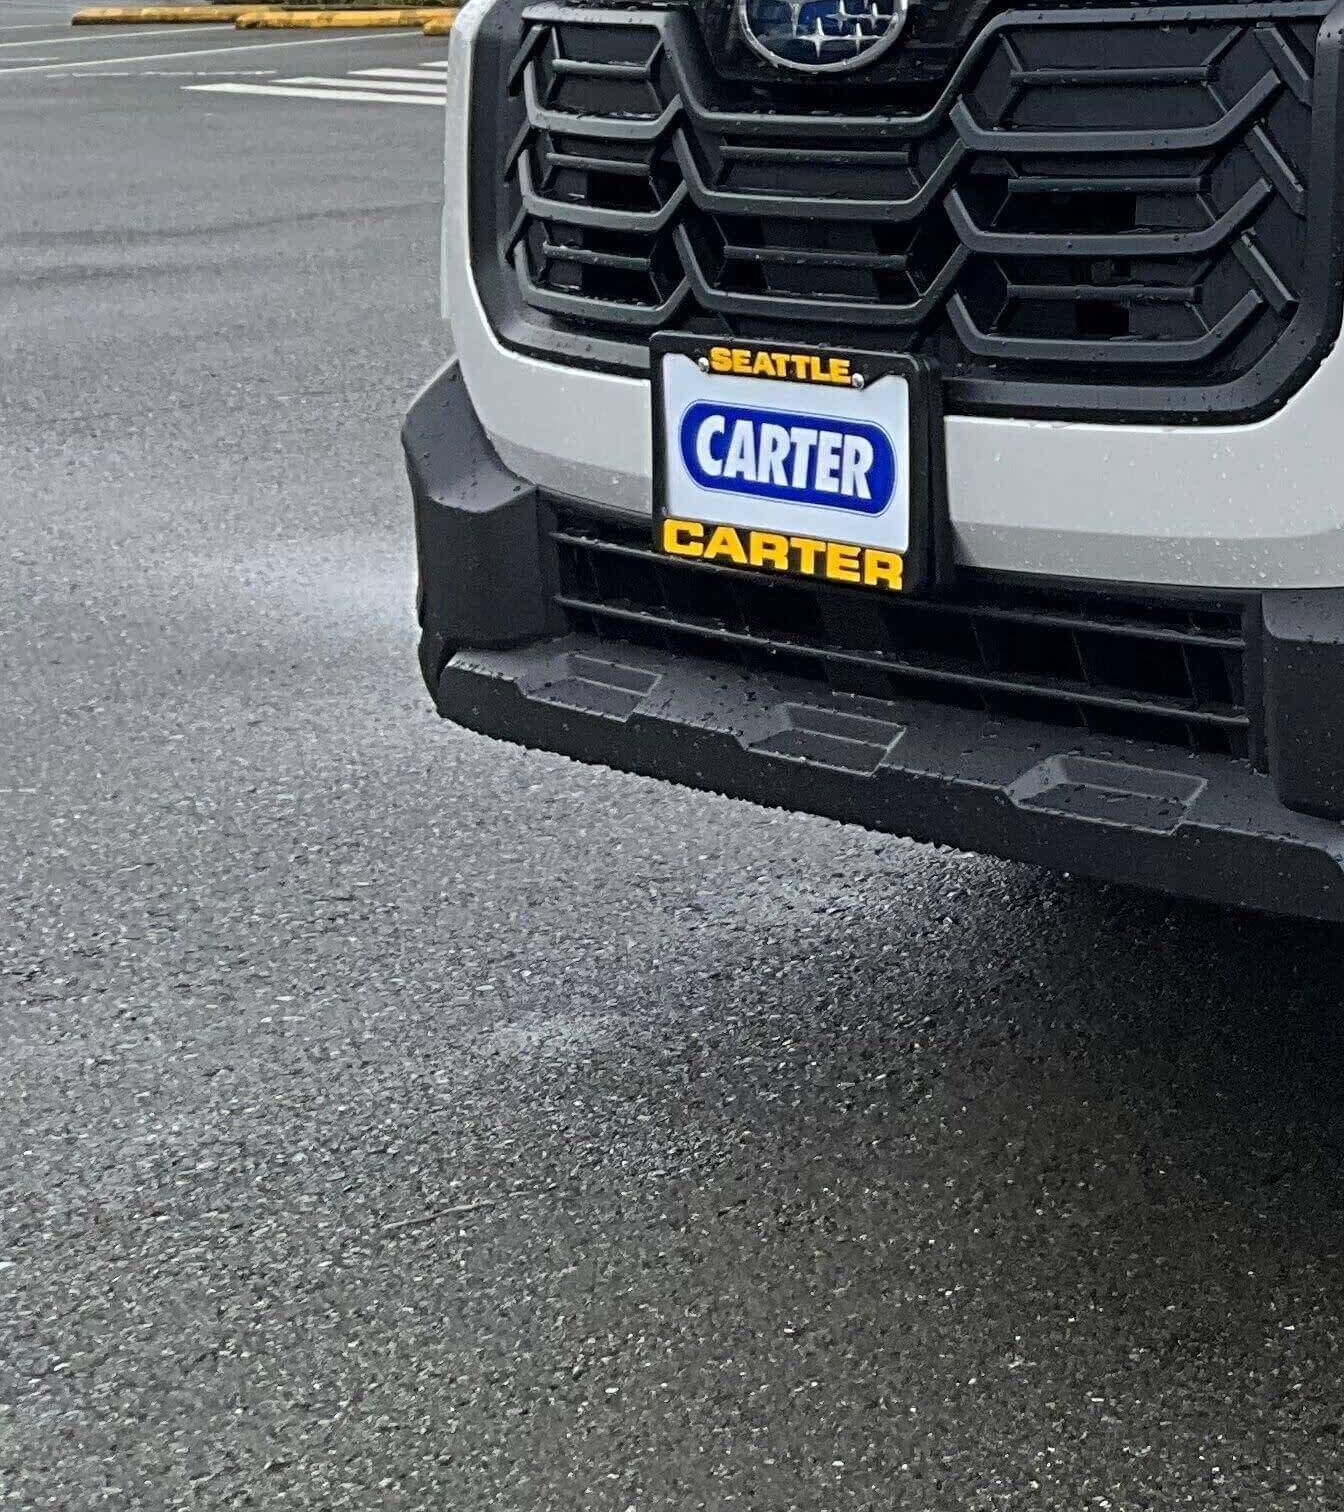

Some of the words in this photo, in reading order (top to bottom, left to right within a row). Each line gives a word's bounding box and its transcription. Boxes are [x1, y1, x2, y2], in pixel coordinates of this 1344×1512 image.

[709, 346, 851, 385] SEATTLE
[696, 414, 875, 500] CARTER
[663, 518, 903, 590] CARTER
